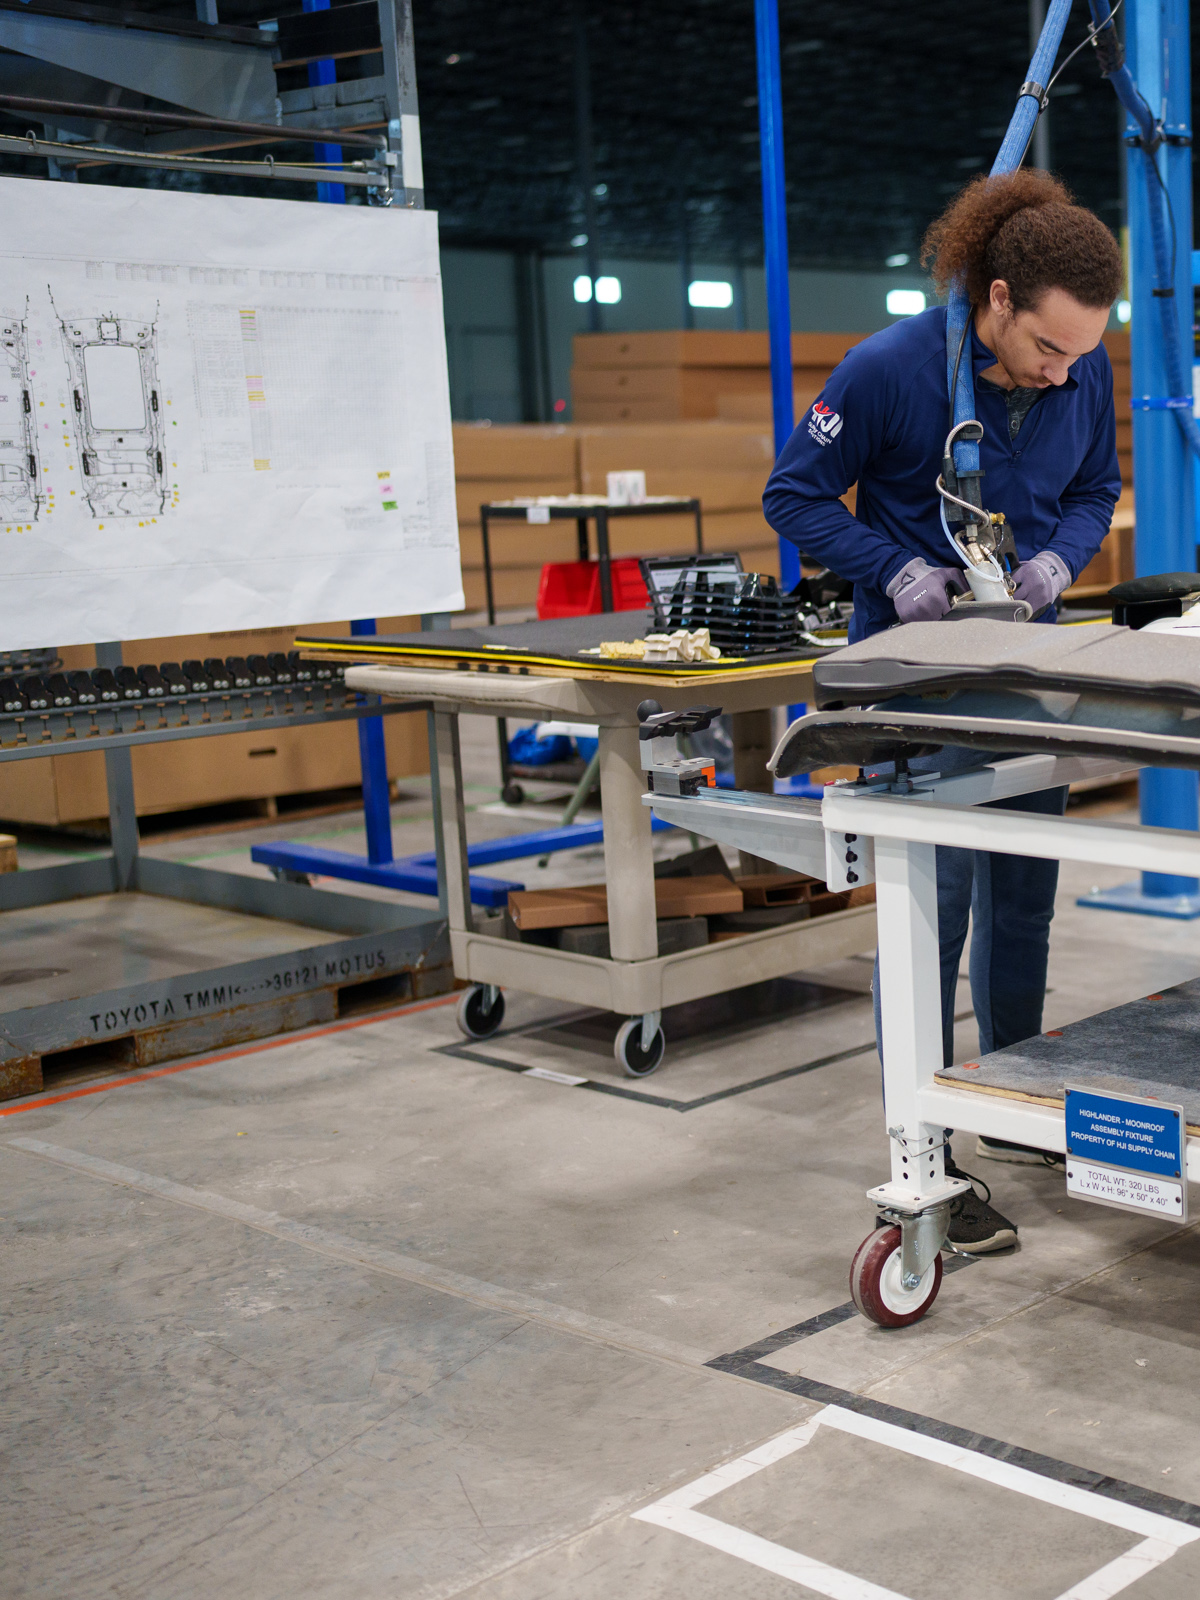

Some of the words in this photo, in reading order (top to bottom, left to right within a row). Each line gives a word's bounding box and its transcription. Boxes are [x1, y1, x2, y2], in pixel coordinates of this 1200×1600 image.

[89, 998, 175, 1033] TOYOTA
[325, 950, 386, 976] MOTUS
[1079, 1108, 1121, 1124] HIGHLANDER
[1125, 1118, 1165, 1133] MOONROOF
[1090, 1123, 1125, 1137] ASSEMBLY
[1125, 1130, 1154, 1143] FIXTURE
[1071, 1131, 1106, 1145] PROPERTY
[1106, 1138, 1116, 1147] OF
[1116, 1141, 1127, 1150] HJI
[1127, 1143, 1154, 1155] SUPPLY
[1154, 1149, 1175, 1160] CHAIN
[1087, 1170, 1112, 1184] TOTAL
[1112, 1176, 1127, 1187] WT:
[1128, 1180, 1142, 1191] 320
[1144, 1183, 1160, 1194] LBS
[1092, 1181, 1100, 1191] W
[1107, 1185, 1115, 1195] H:
